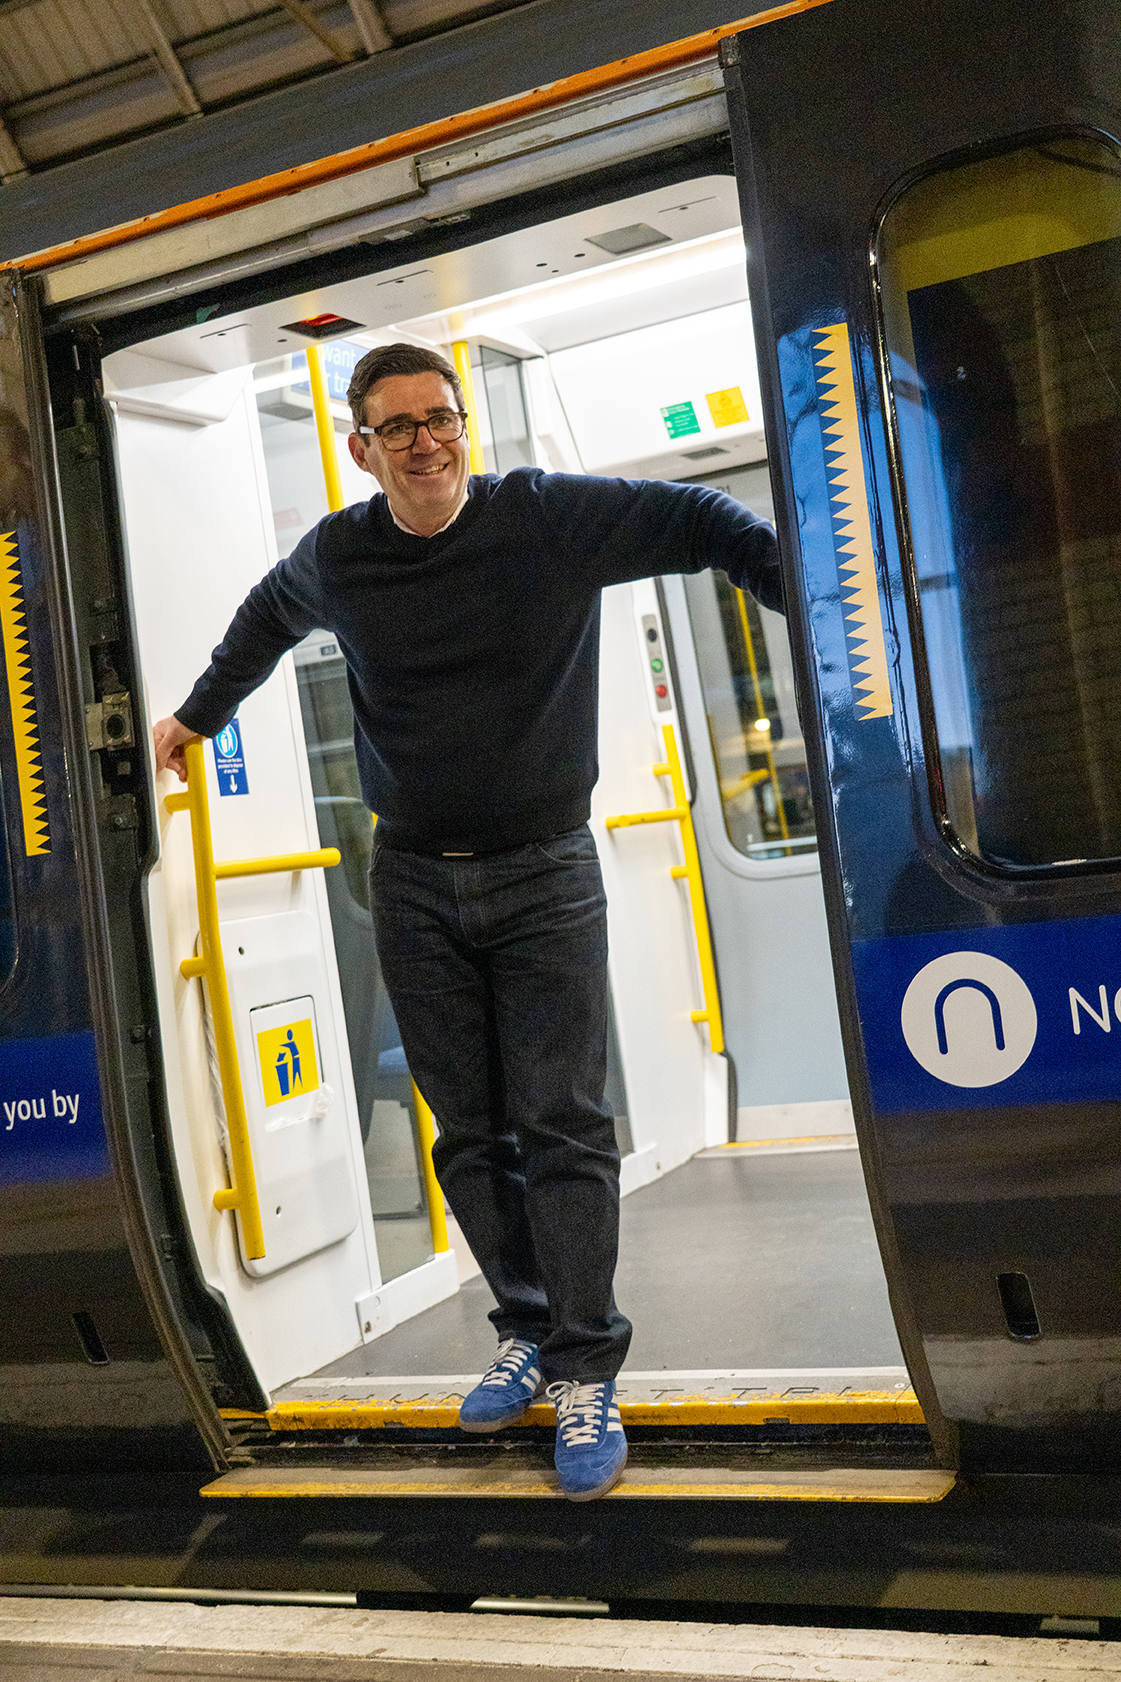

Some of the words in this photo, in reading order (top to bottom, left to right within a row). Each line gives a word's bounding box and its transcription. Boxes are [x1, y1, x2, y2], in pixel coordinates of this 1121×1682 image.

[1068, 984, 1121, 1035] N
[3, 1098, 46, 1130] you
[52, 1089, 80, 1124] by
